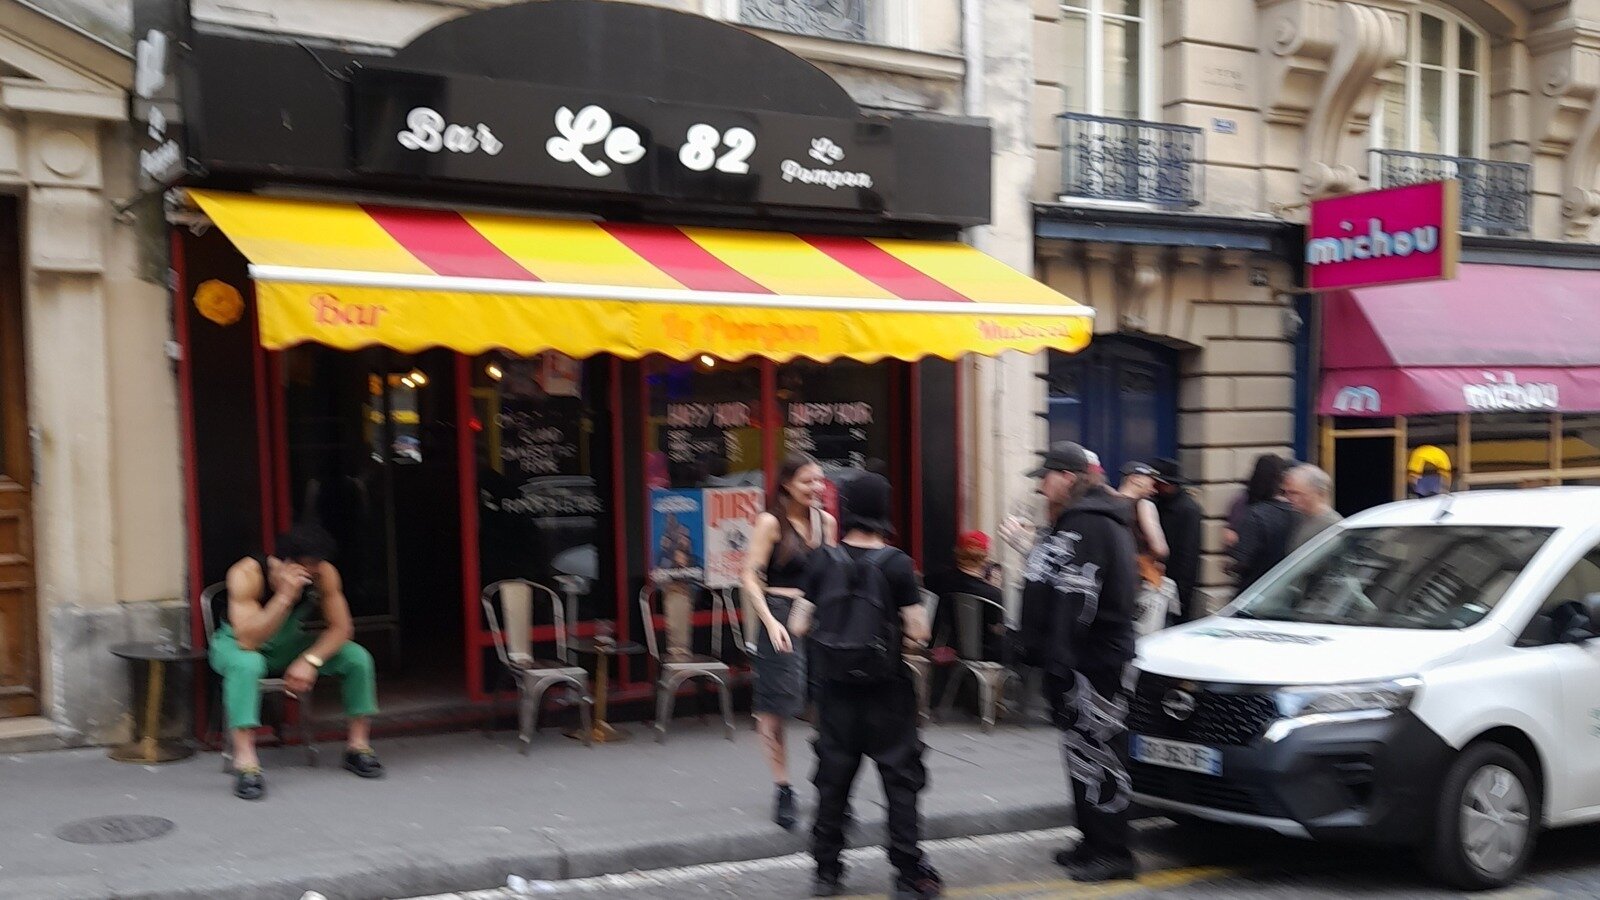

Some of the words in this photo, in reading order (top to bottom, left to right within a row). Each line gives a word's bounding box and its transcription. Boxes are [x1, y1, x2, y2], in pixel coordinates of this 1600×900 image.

[397, 107, 504, 155] Bar
[545, 104, 646, 177] Le
[678, 123, 757, 175] 82
[1305, 217, 1439, 265] michou
[309, 292, 388, 328] Bar
[1332, 385, 1382, 412] m
[1462, 371, 1560, 410] michou
